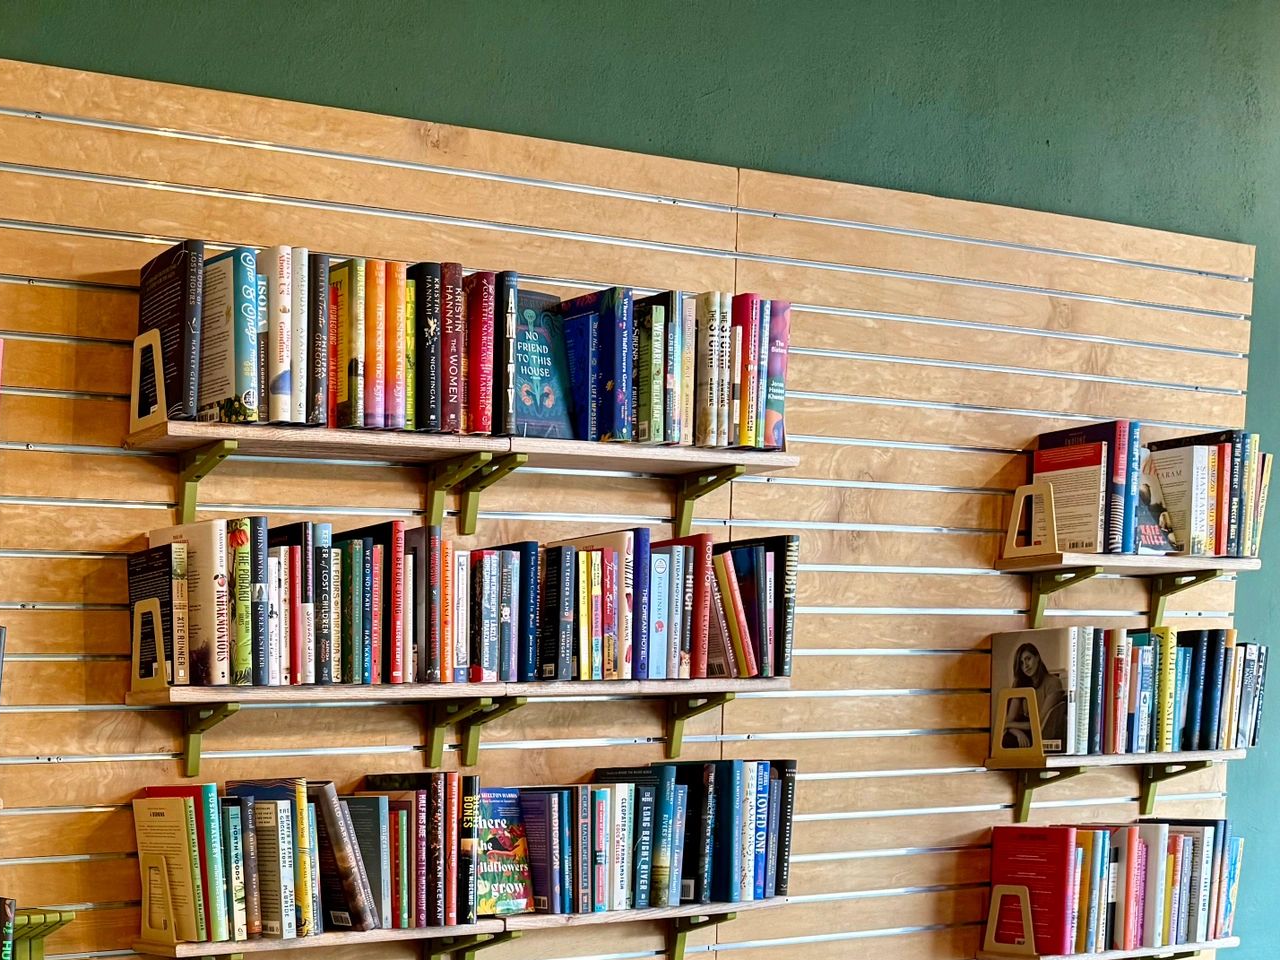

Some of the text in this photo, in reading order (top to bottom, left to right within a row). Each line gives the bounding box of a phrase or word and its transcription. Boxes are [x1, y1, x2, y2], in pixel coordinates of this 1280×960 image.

[258, 280, 267, 327] ISOLA
[445, 286, 454, 334] HANNAH
[517, 342, 549, 354] FRIEND
[525, 331, 539, 340] NO
[653, 322, 663, 364] WEYWARD
[517, 353, 552, 366] TO THIS
[521, 366, 550, 377] HOUSE
[449, 354, 458, 403] WOMEN
[321, 530, 329, 558] KEEPER
[1141, 525, 1160, 535] KATE
[1141, 534, 1165, 545] RILEY
[216, 590, 228, 662] INHARMONIOUS
[177, 636, 185, 666] RUNNER
[755, 794, 768, 854] LOVED ONE
[490, 881, 526, 898] grow
